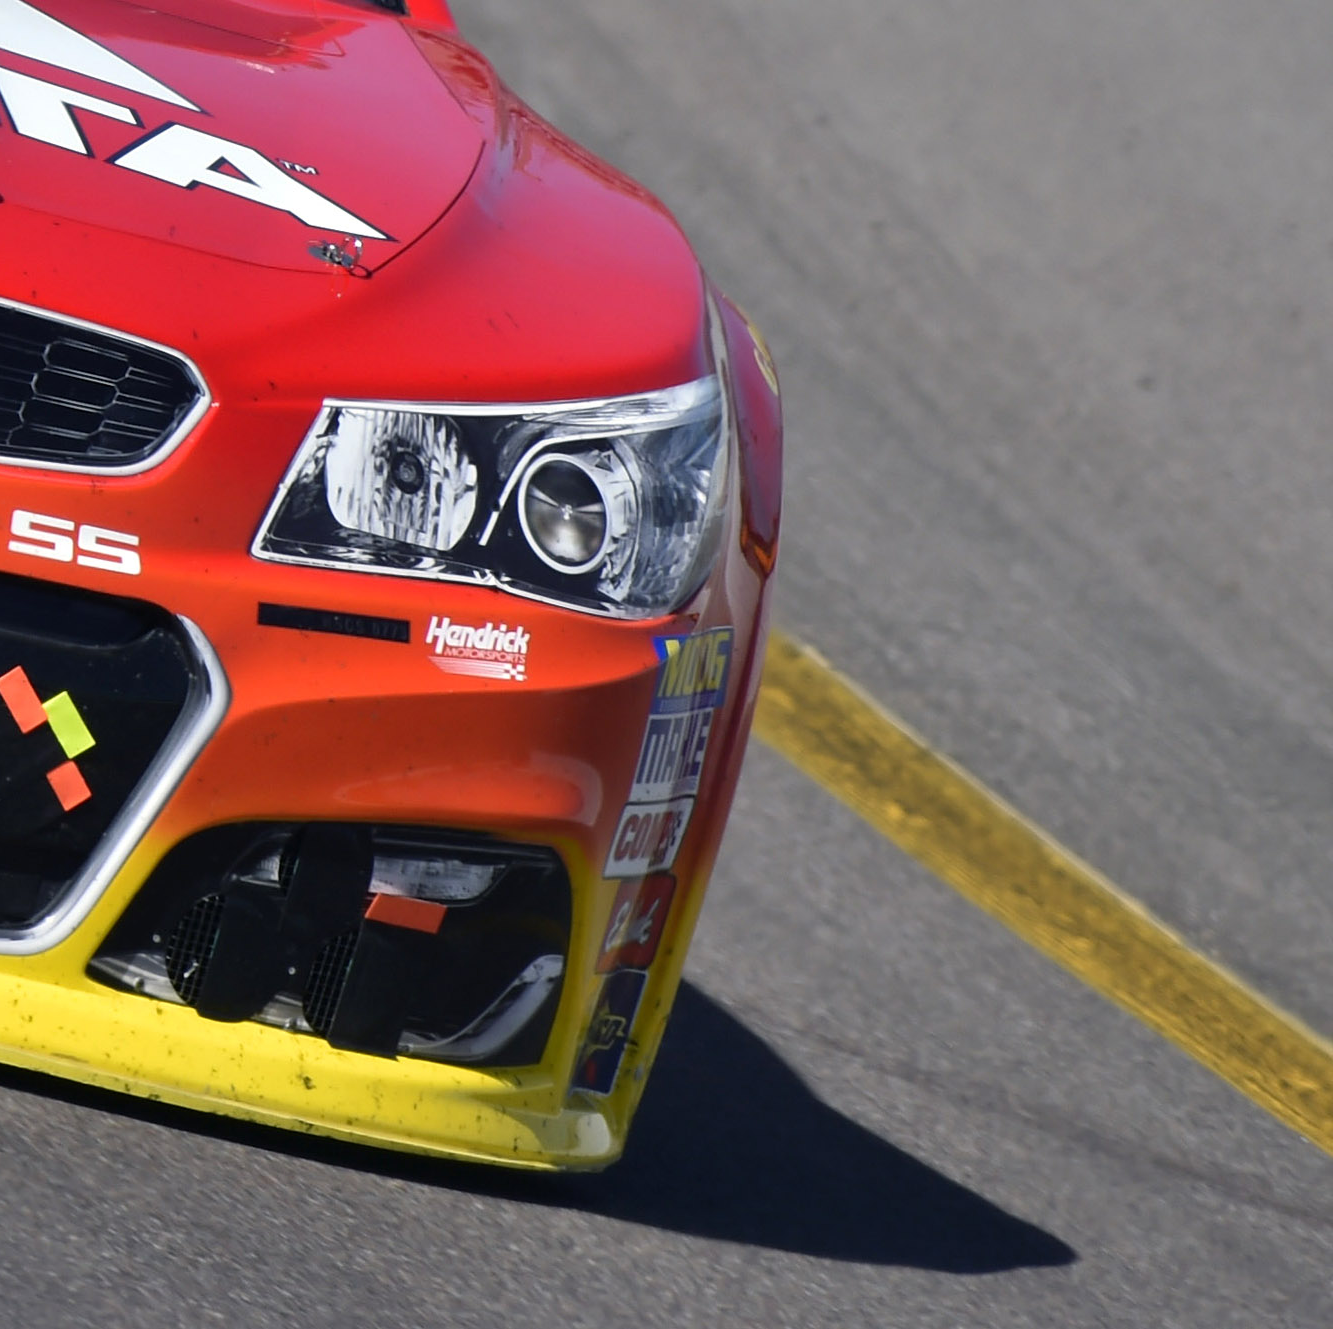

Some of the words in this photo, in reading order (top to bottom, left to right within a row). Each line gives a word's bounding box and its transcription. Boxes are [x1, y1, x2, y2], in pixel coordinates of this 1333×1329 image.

[8, 508, 143, 577] SS
[425, 615, 531, 654] Hendrick
[443, 647, 527, 664] MOTORSPORTS
